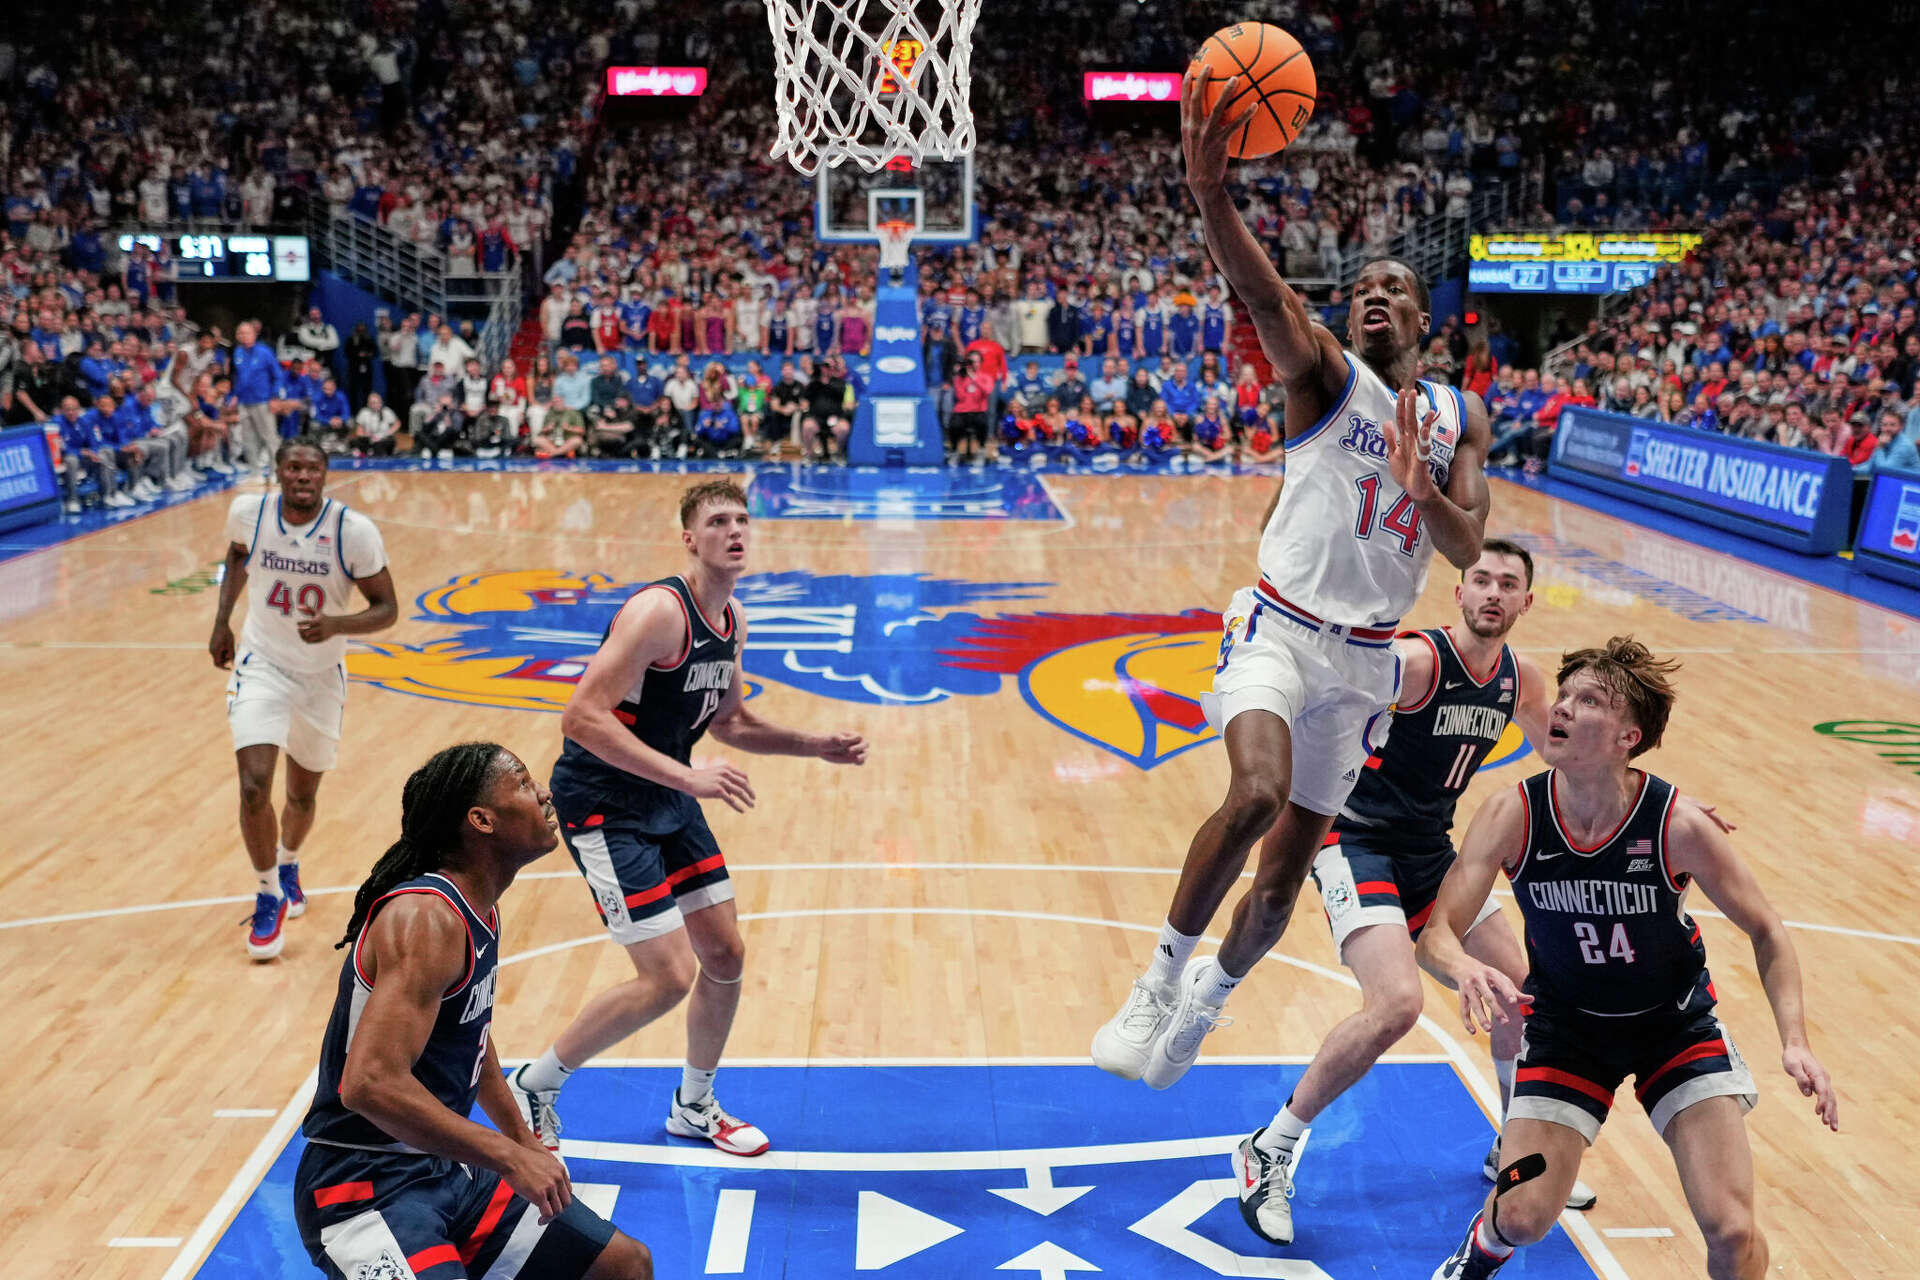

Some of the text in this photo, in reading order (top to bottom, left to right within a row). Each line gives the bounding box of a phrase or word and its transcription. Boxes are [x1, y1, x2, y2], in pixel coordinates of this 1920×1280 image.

[1641, 439, 1709, 488] SHELTER
[1706, 453, 1824, 519] INSURANCE
[1355, 472, 1423, 558] 14
[261, 549, 330, 576] Kansas
[266, 579, 326, 618] 40
[1443, 743, 1477, 789] 11
[1528, 879, 1658, 915] CONNECTICUT
[1573, 922, 1635, 964] 24
